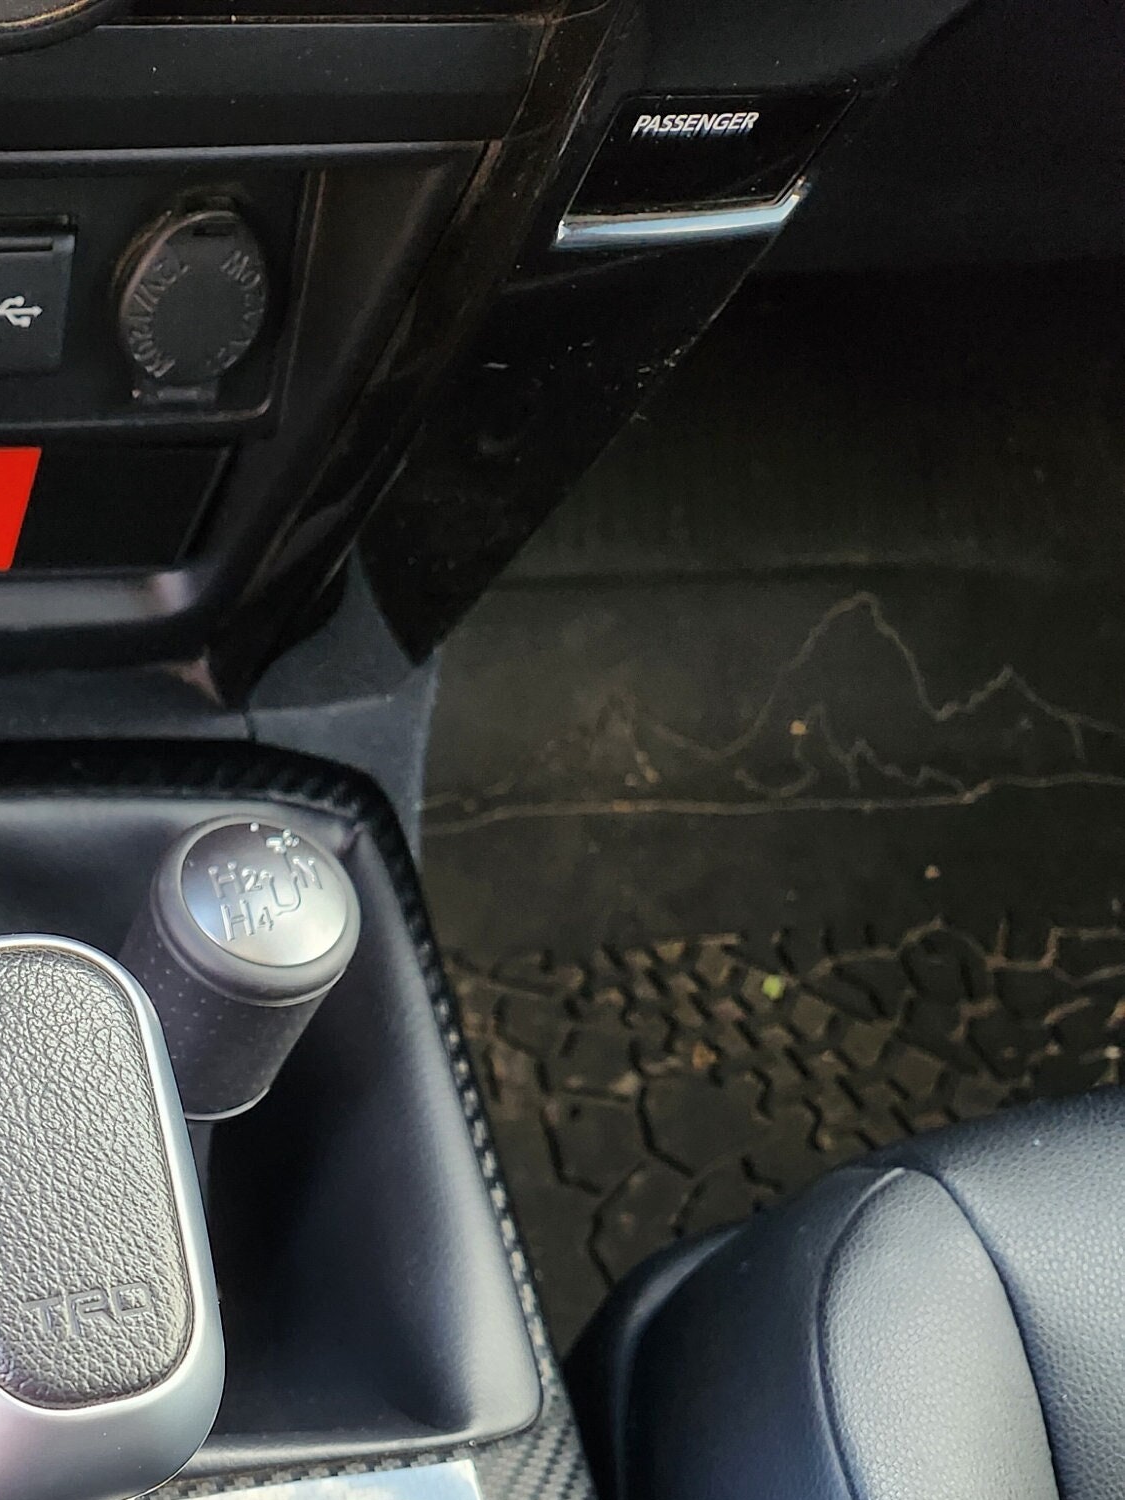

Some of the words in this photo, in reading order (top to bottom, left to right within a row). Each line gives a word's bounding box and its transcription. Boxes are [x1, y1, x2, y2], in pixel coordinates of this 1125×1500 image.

[631, 112, 759, 137] PASSENGER
[208, 865, 264, 898] H2
[220, 898, 274, 942] H4
[24, 1281, 154, 1337] TRD
